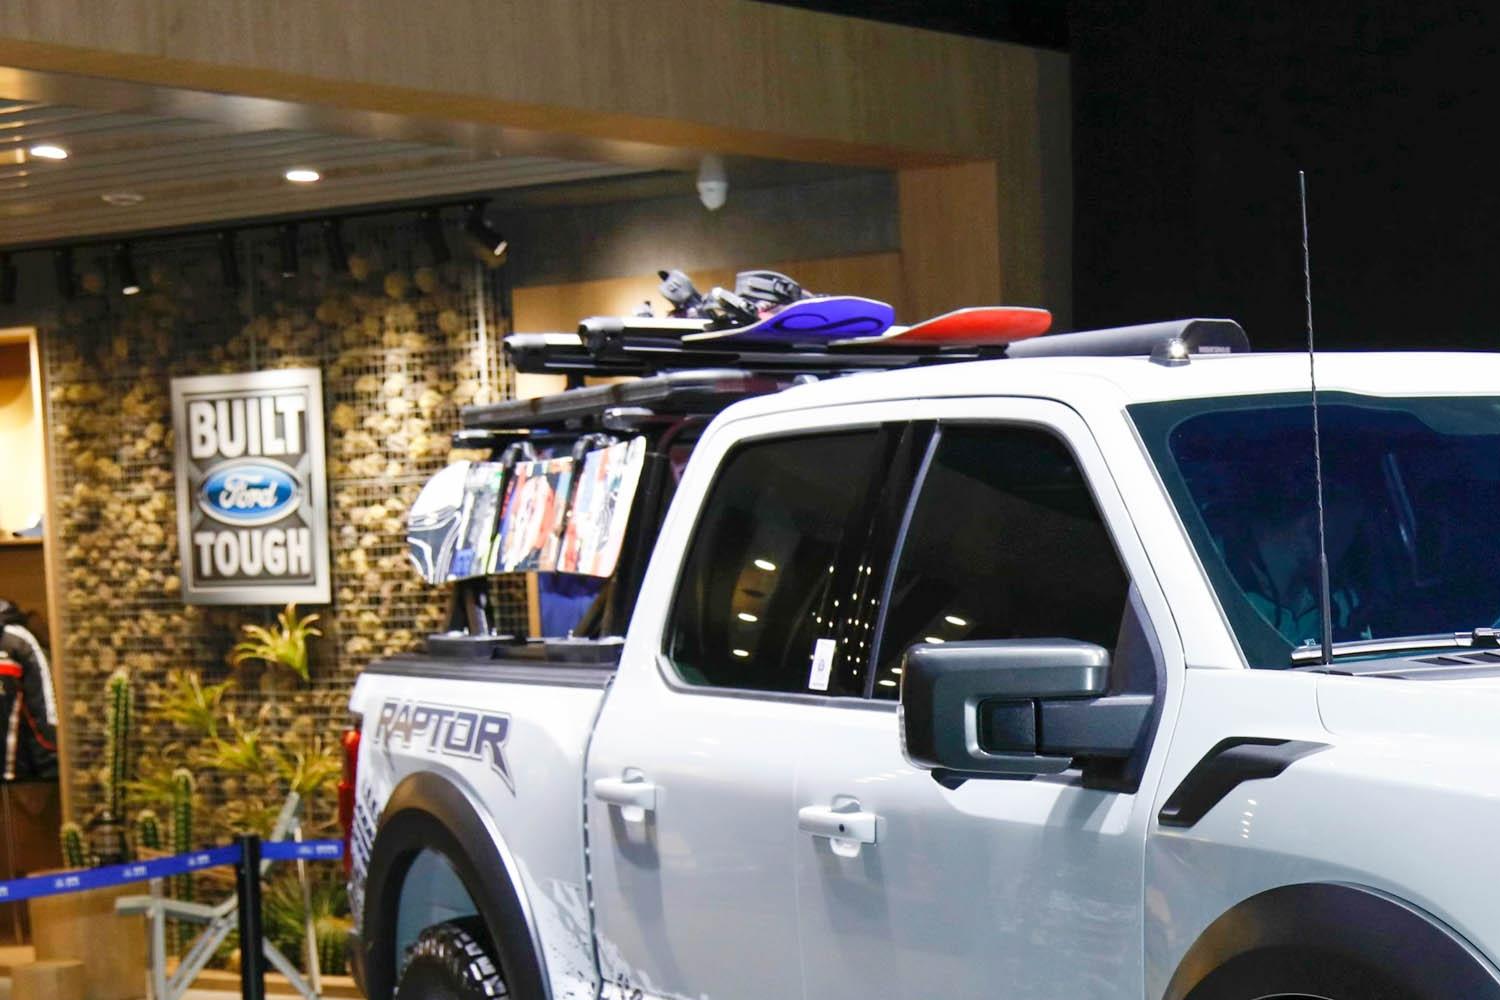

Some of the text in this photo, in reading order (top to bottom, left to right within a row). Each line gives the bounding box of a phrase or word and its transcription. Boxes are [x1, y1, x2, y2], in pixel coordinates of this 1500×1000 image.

[189, 395, 305, 459] BUILT
[219, 474, 279, 509] Ford
[194, 528, 311, 577] TOUGH
[375, 699, 514, 787] RAPTOR
